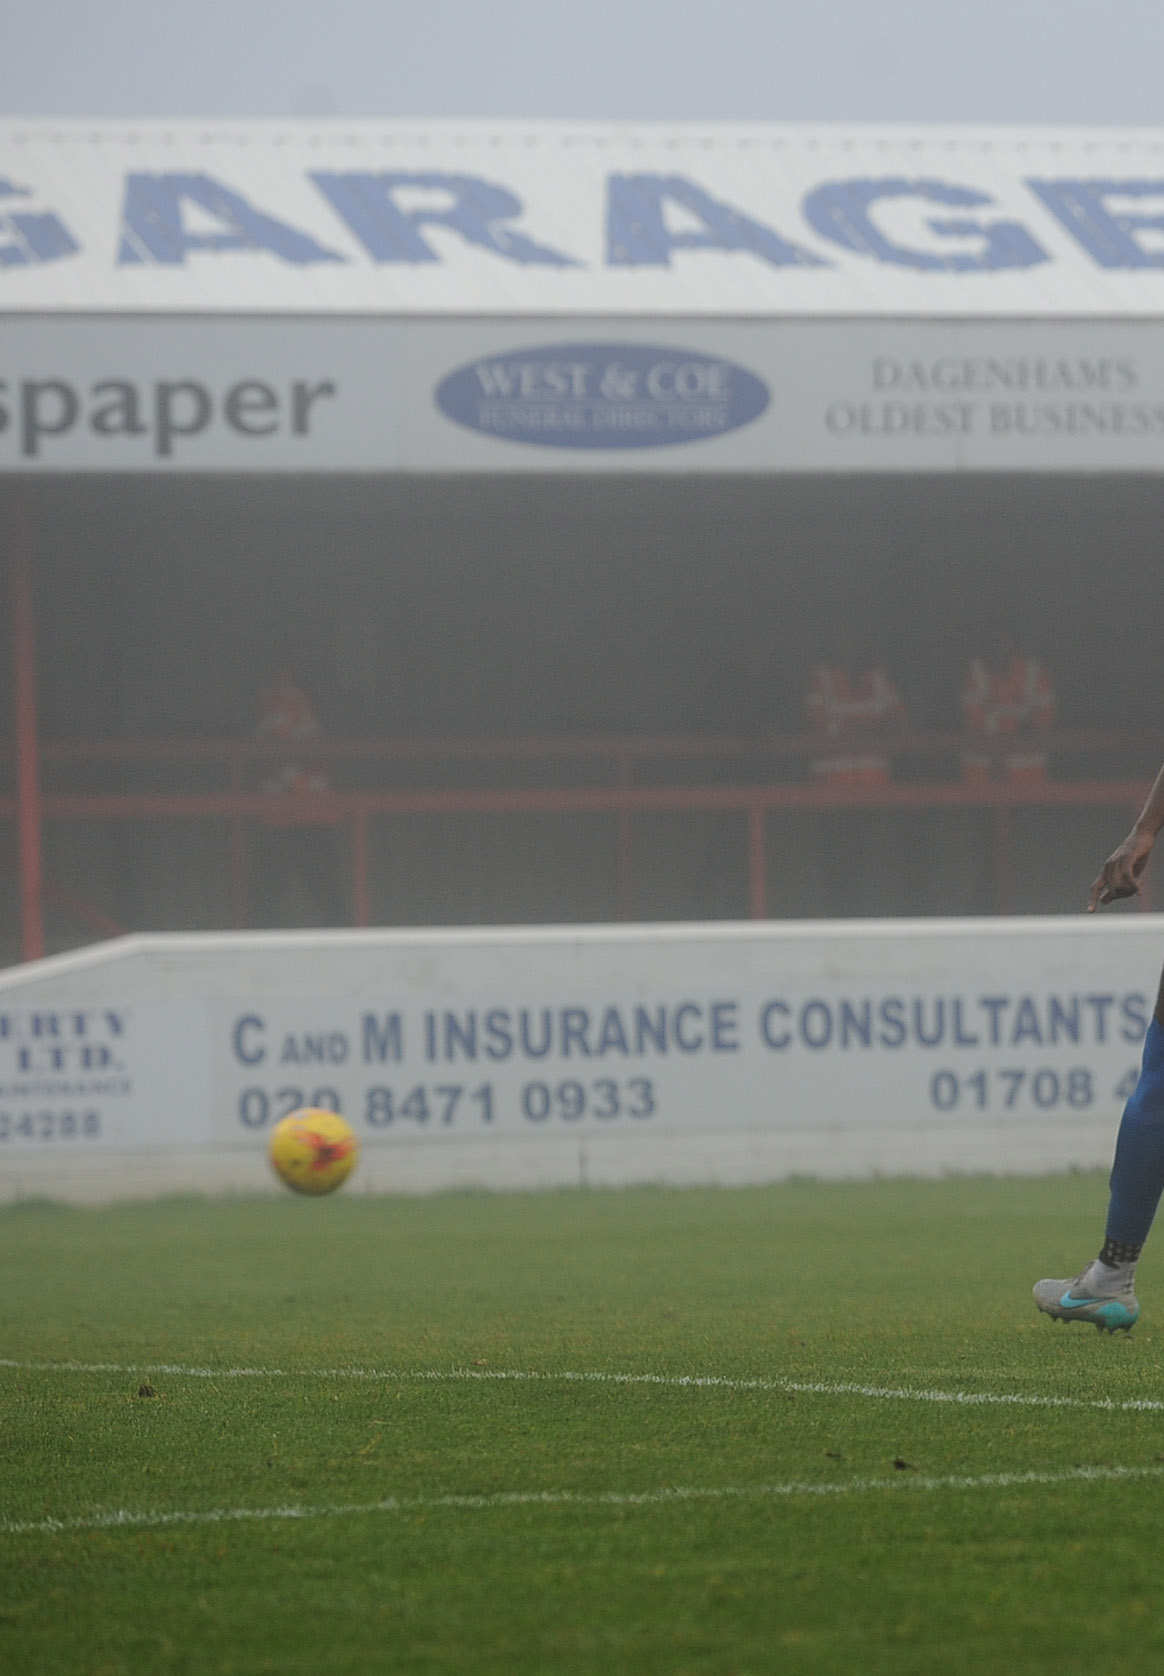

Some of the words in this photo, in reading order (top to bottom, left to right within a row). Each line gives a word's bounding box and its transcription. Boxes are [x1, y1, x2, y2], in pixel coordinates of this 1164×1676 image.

[474, 361, 594, 398] WEST
[600, 361, 640, 399] &
[646, 361, 731, 398] COE
[0, 377, 337, 457] paper
[824, 402, 976, 438] OLDEST
[232, 1012, 266, 1067] C
[279, 1031, 350, 1066] AND
[361, 1010, 404, 1065] M
[423, 1002, 739, 1062] INSURANCE
[760, 994, 1148, 1050] CONSULTANTS
[17, 1045, 125, 1071] LTD.
[365, 1081, 494, 1127] 8471
[520, 1075, 657, 1123] 0933
[928, 1065, 1095, 1113] 01708
